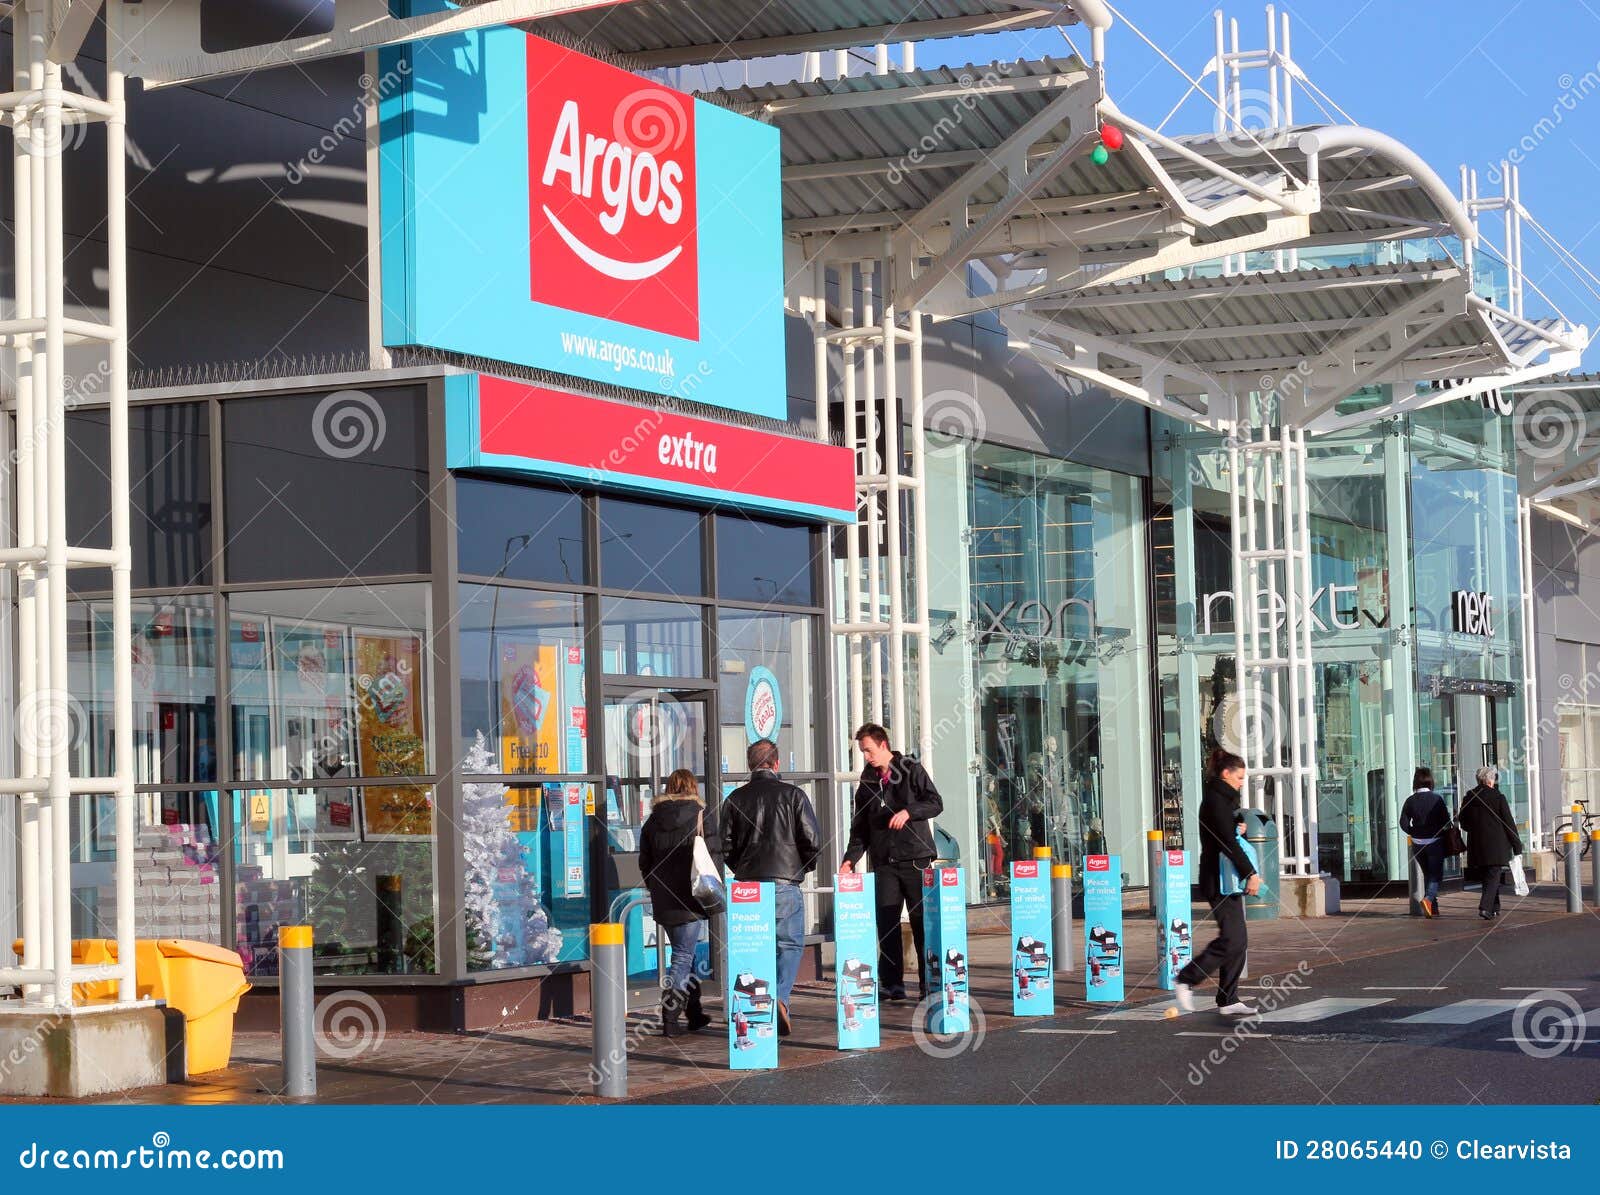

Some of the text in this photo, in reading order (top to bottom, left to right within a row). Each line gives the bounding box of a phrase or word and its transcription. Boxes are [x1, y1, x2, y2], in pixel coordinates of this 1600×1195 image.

[542, 99, 684, 235] Argos
[560, 332, 675, 376] www.argos.co.uk
[657, 431, 717, 474] extra
[1203, 582, 1361, 636] next
[1457, 589, 1495, 636] next
[510, 742, 531, 760] Free
[1016, 865, 1036, 873] Argos
[734, 887, 758, 897] Argos
[732, 912, 761, 921] Peace
[744, 923, 769, 933] mind
